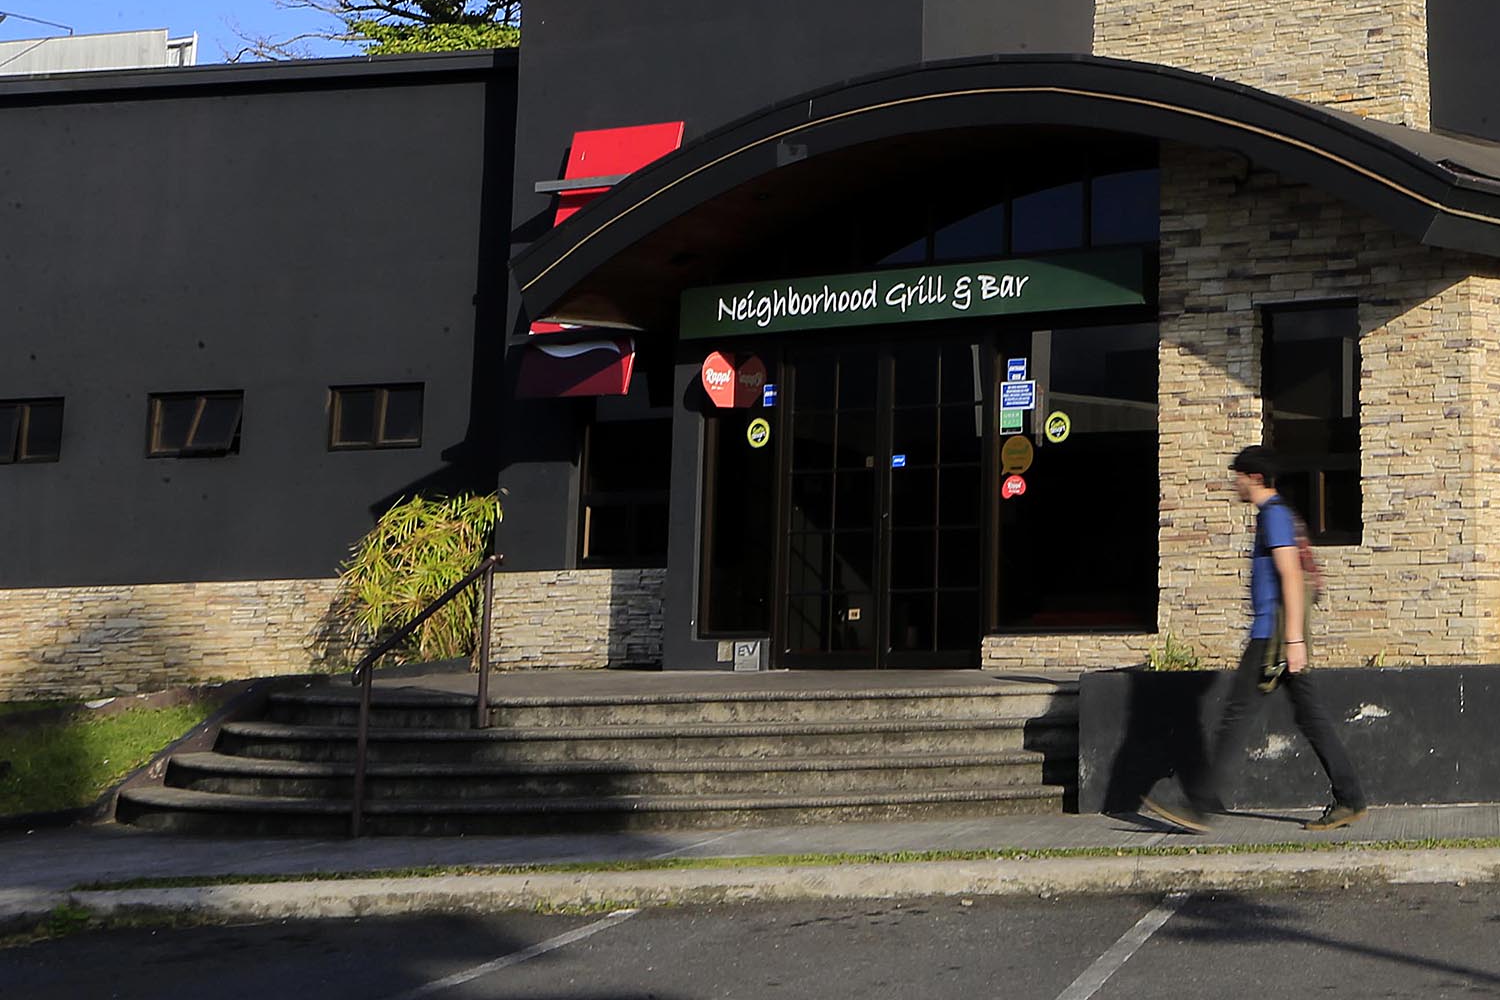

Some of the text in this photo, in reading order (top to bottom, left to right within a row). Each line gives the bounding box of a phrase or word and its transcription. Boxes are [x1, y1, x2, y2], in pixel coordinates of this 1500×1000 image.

[717, 274, 1030, 327] Neighborhood Grill & Bar
